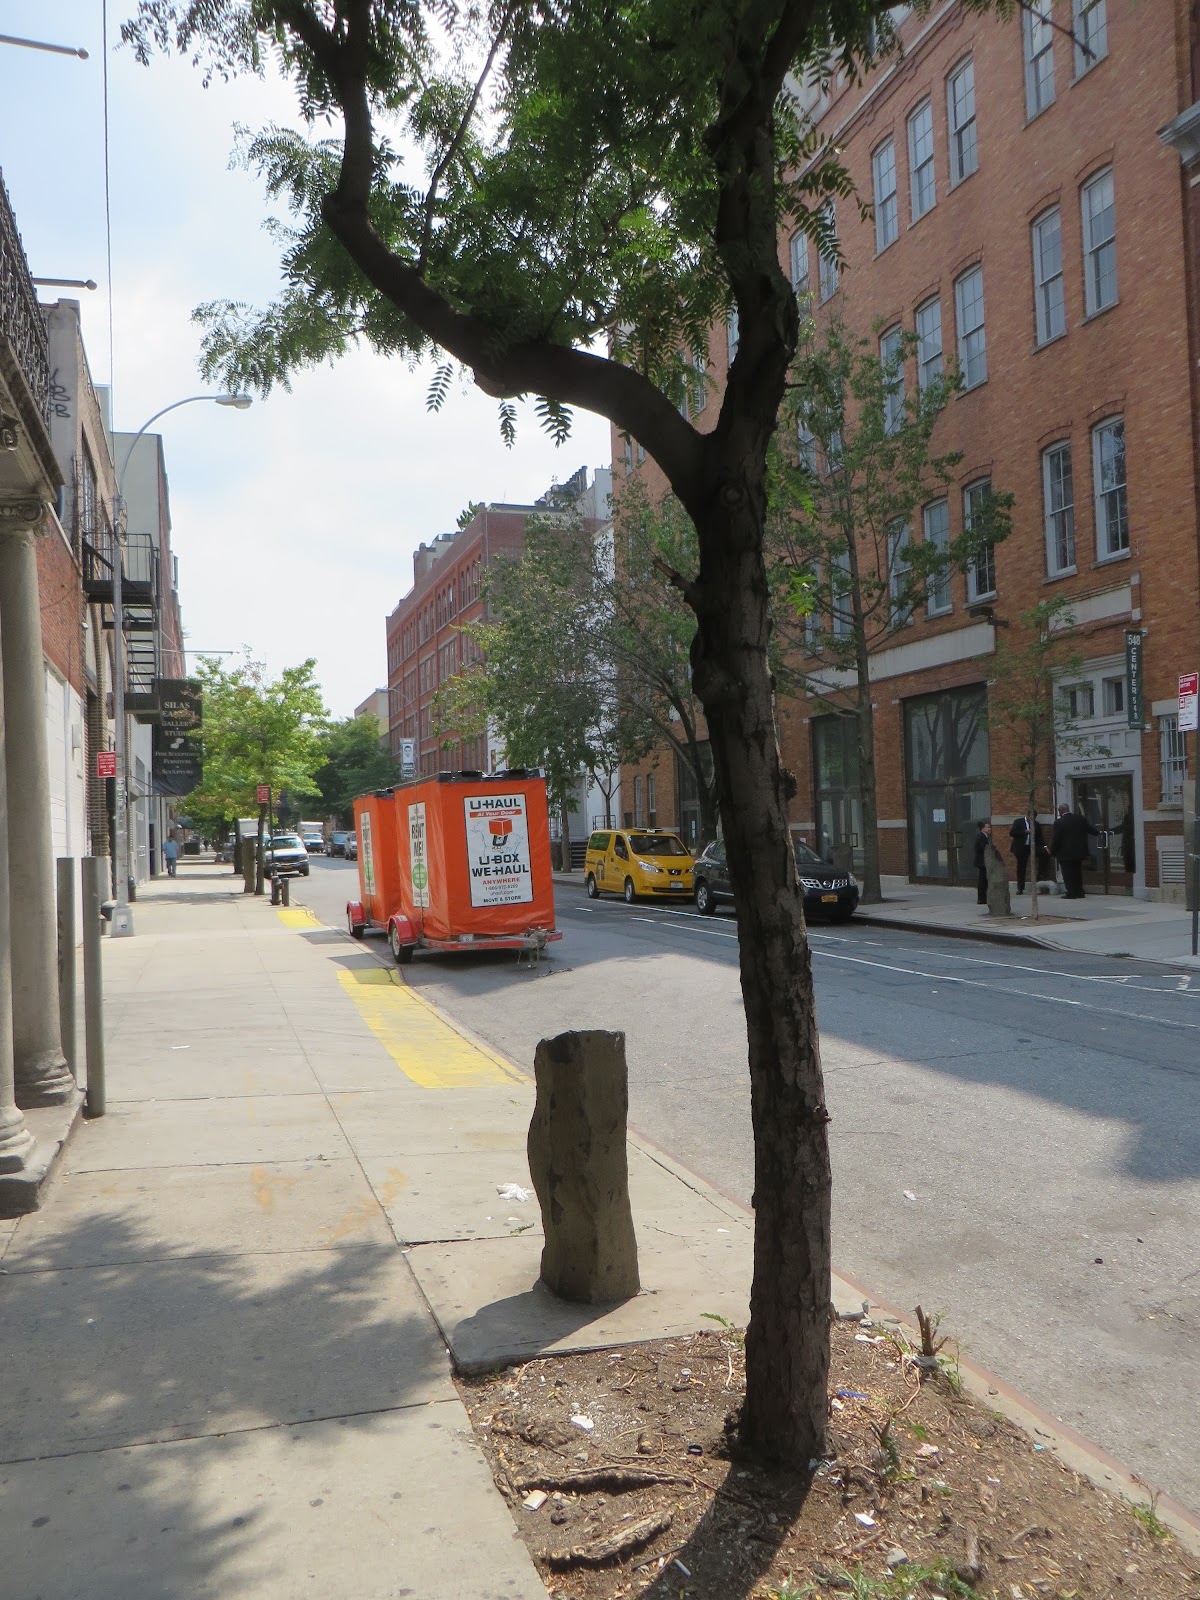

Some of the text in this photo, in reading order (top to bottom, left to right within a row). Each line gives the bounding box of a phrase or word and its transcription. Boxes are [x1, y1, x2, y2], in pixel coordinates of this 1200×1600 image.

[1128, 634, 1141, 646] 548
[164, 701, 190, 709] SILAS
[469, 798, 521, 810] U-HAUL
[478, 853, 520, 866] U-BOX
[471, 863, 530, 878] WE-HAUL
[482, 877, 521, 886] ANYWHERE
